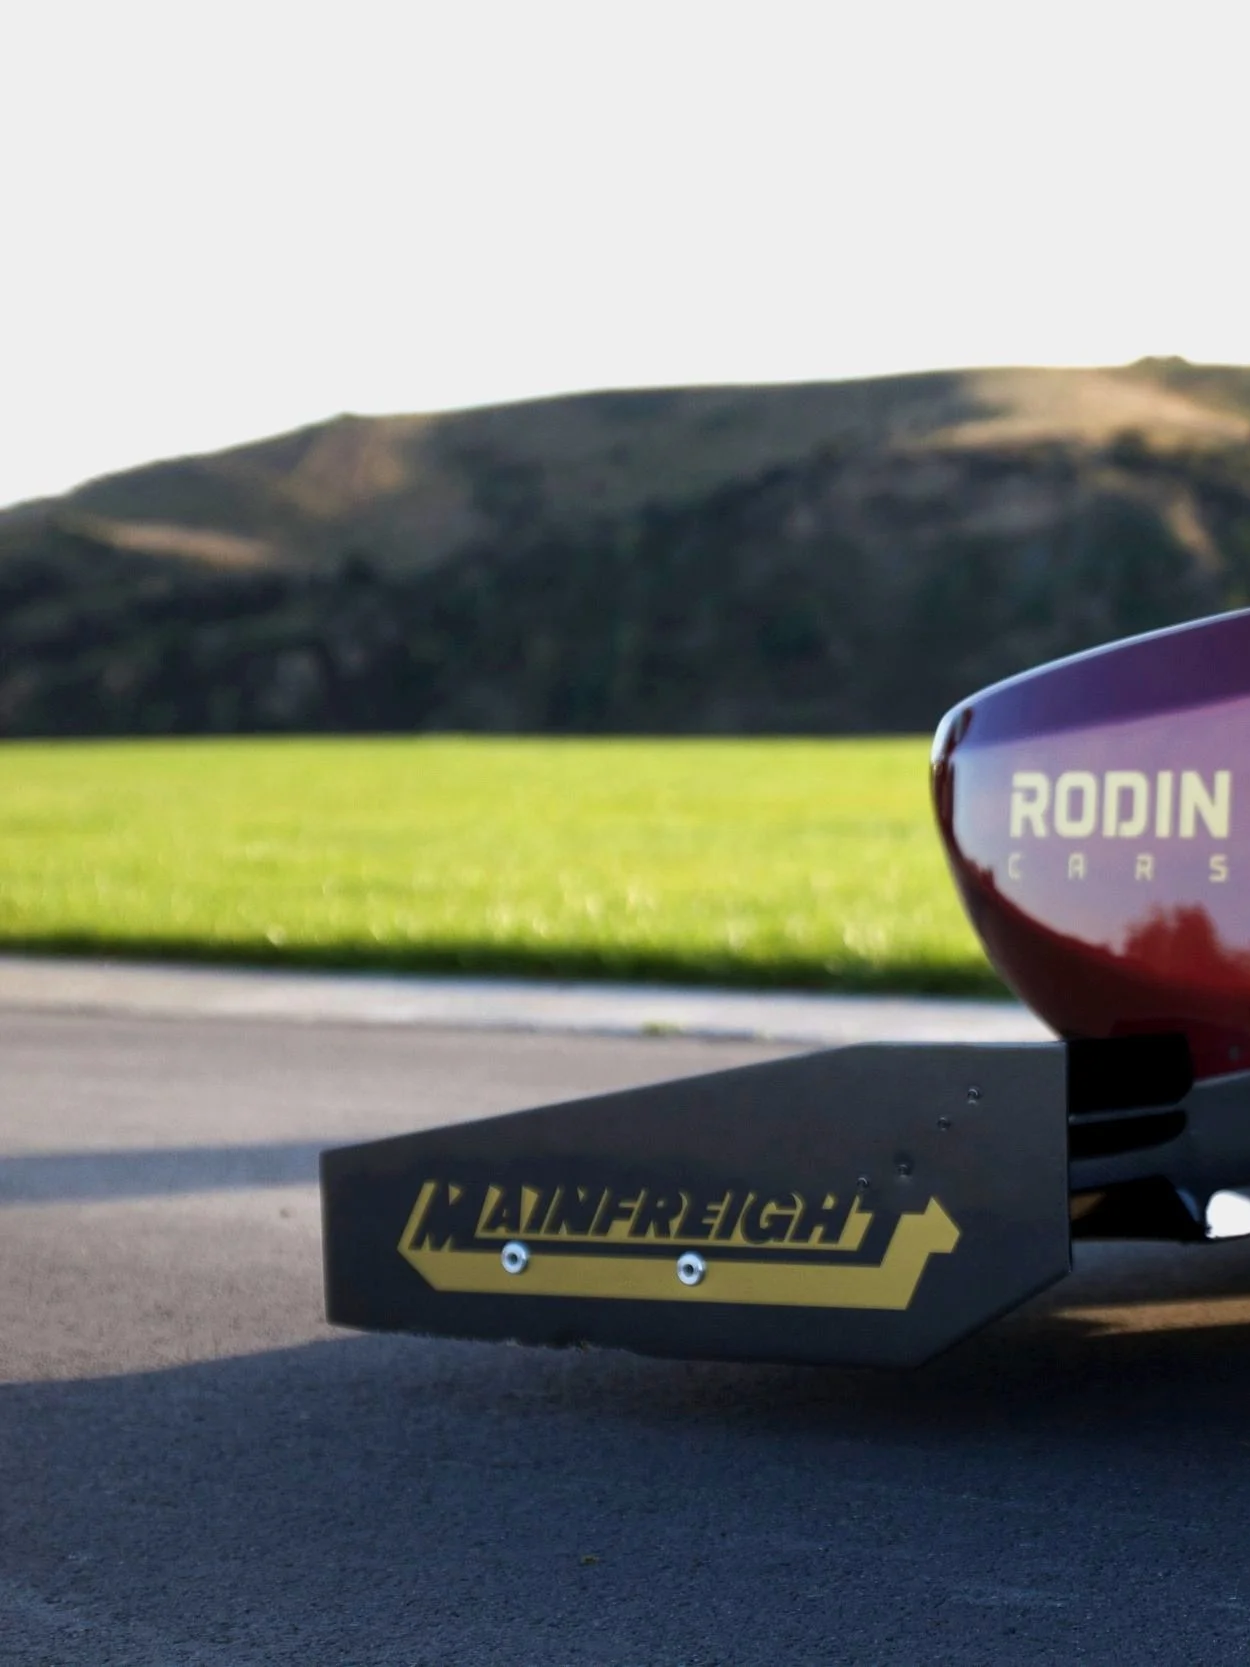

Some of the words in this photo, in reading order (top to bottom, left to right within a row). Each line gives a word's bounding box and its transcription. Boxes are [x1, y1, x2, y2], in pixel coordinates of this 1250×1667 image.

[1009, 770, 1231, 839] RODIN
[1008, 852, 1230, 882] CARS
[408, 1180, 916, 1268] MAINFREIGHT
